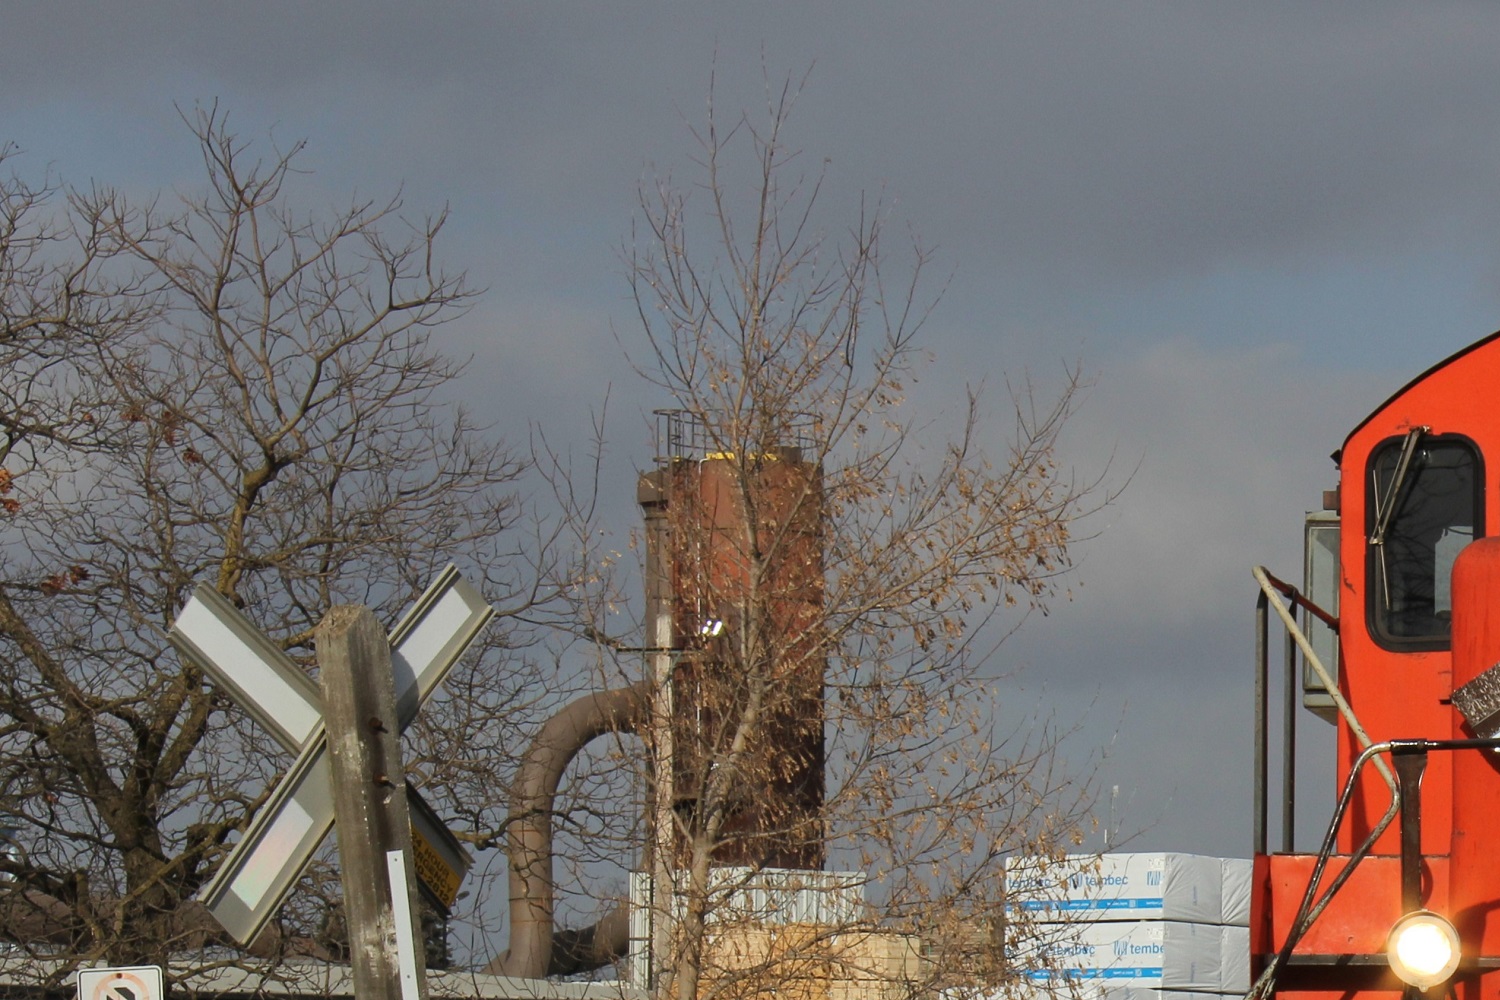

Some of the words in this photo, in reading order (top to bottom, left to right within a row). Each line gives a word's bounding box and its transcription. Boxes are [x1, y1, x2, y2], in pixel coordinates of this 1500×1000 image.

[412, 845, 453, 893] ERGENCY
[424, 847, 450, 878] HOUR
[1130, 943, 1164, 955] tembe
